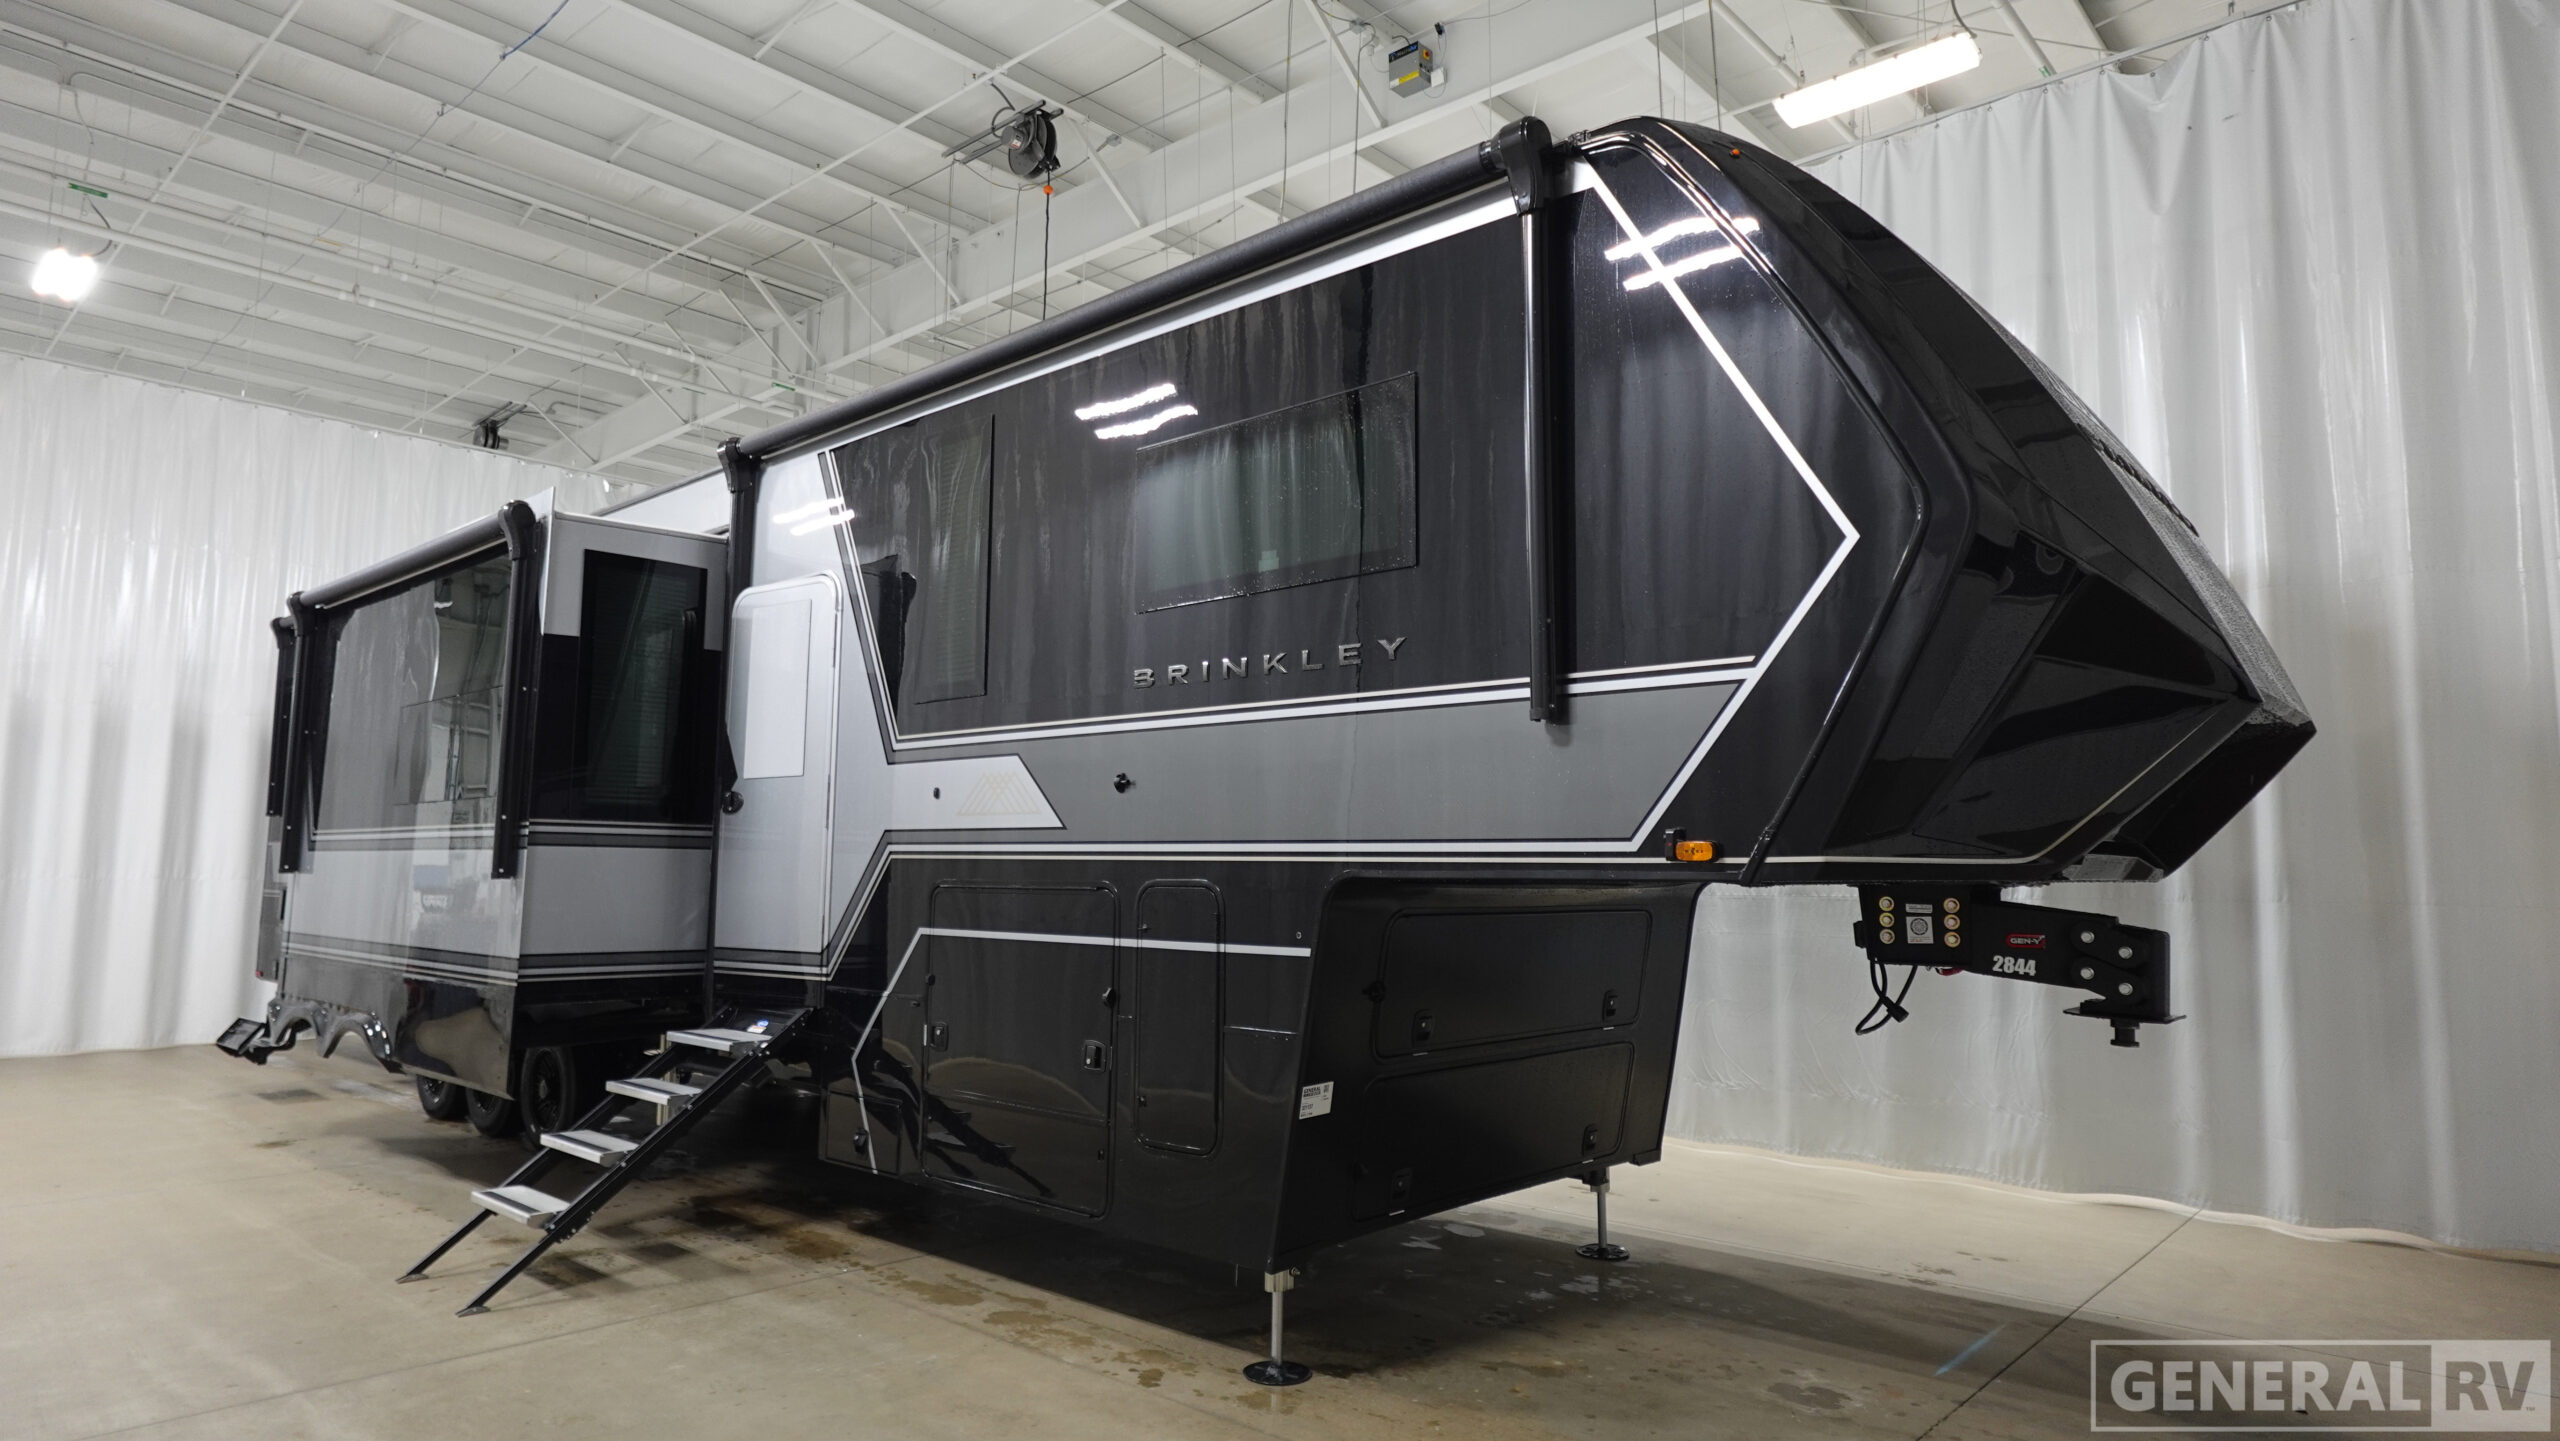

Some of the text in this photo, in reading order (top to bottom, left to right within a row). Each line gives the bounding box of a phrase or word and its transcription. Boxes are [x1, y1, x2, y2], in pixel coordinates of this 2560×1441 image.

[1132, 637, 1406, 689] BRINKLEY
[2010, 935, 2045, 945] GEN-Y
[1992, 955, 2036, 976] 2844
